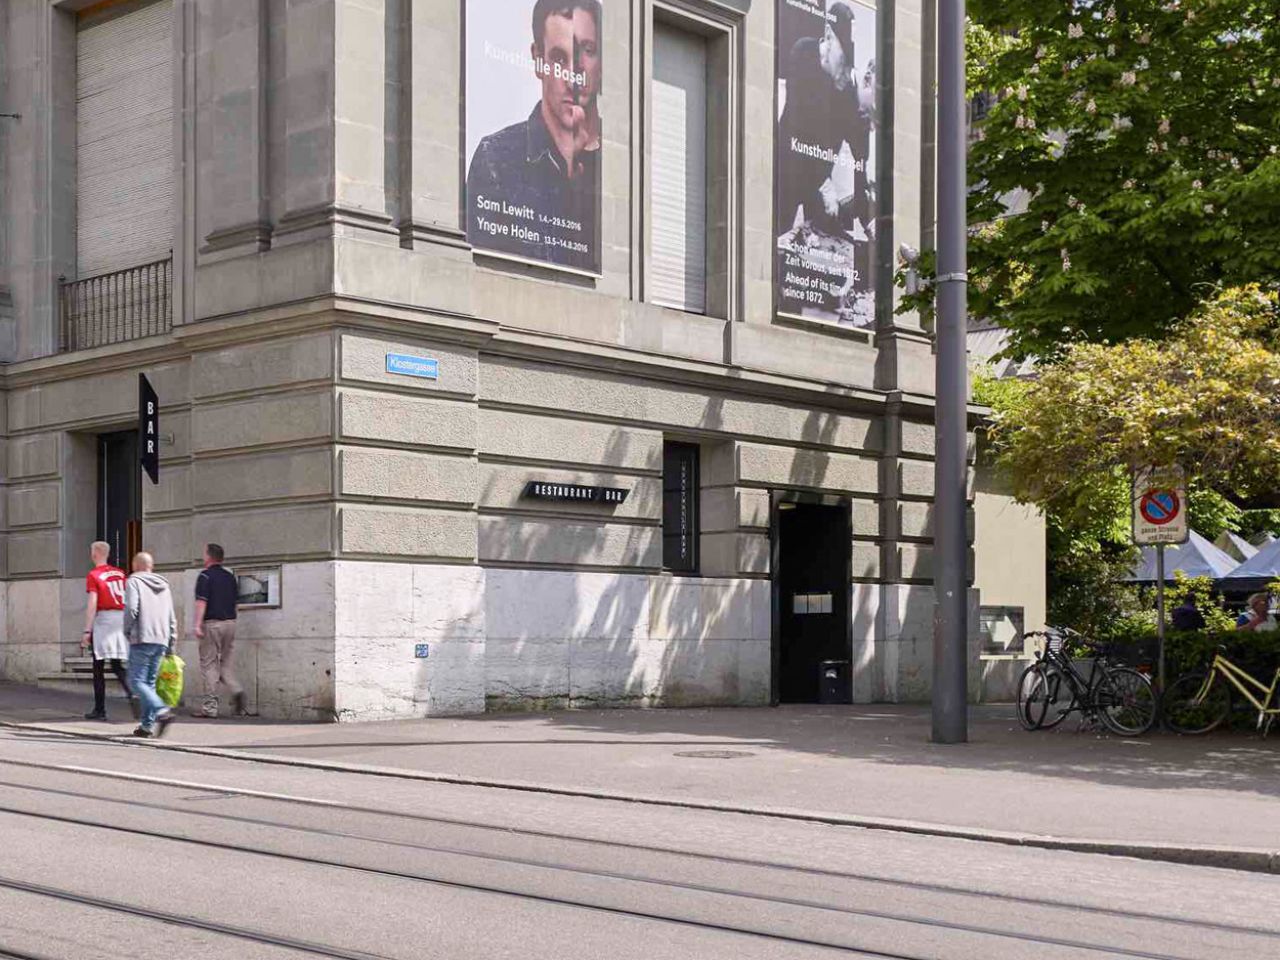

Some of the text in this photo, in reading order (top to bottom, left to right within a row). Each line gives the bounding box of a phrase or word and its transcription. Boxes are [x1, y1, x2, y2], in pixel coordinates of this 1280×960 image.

[483, 40, 586, 86] Kunsthalle Basel
[791, 137, 864, 172] Kunsthalle Basel
[477, 195, 500, 212] Sam
[503, 201, 534, 220] Lewitt
[477, 217, 508, 235] Yngve
[511, 224, 540, 242] Holen
[785, 254, 800, 267] Zeit
[801, 259, 827, 274] voraus,
[785, 272, 847, 296] Ahead of its tim
[785, 287, 825, 304] since 1872.
[535, 485, 622, 501] RESTAURANT BAR
[106, 580, 126, 605] 14
